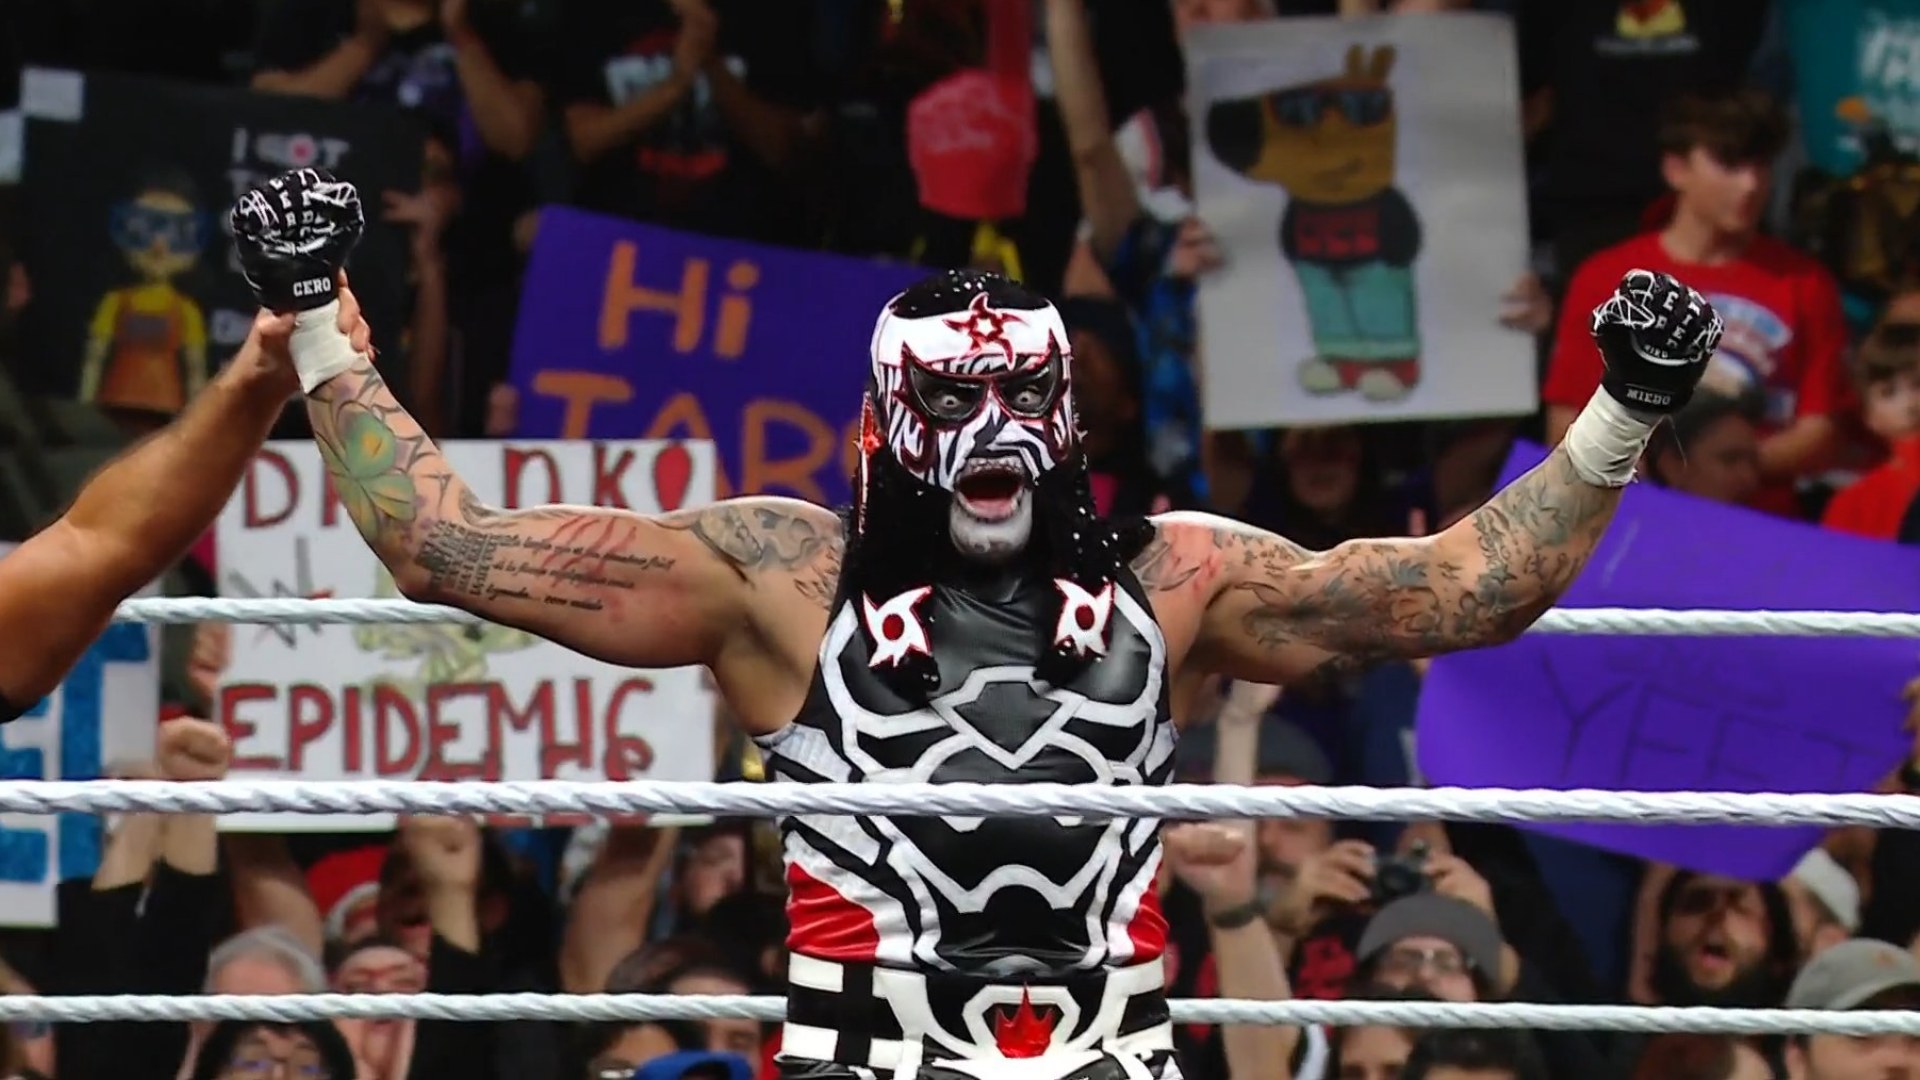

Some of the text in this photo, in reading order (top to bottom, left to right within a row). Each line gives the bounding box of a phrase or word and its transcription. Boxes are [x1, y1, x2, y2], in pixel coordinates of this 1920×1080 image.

[293, 277, 332, 297] CERO
[597, 239, 760, 359] Hi
[1626, 388, 1671, 405] MIEDO
[532, 369, 861, 504] TAR
